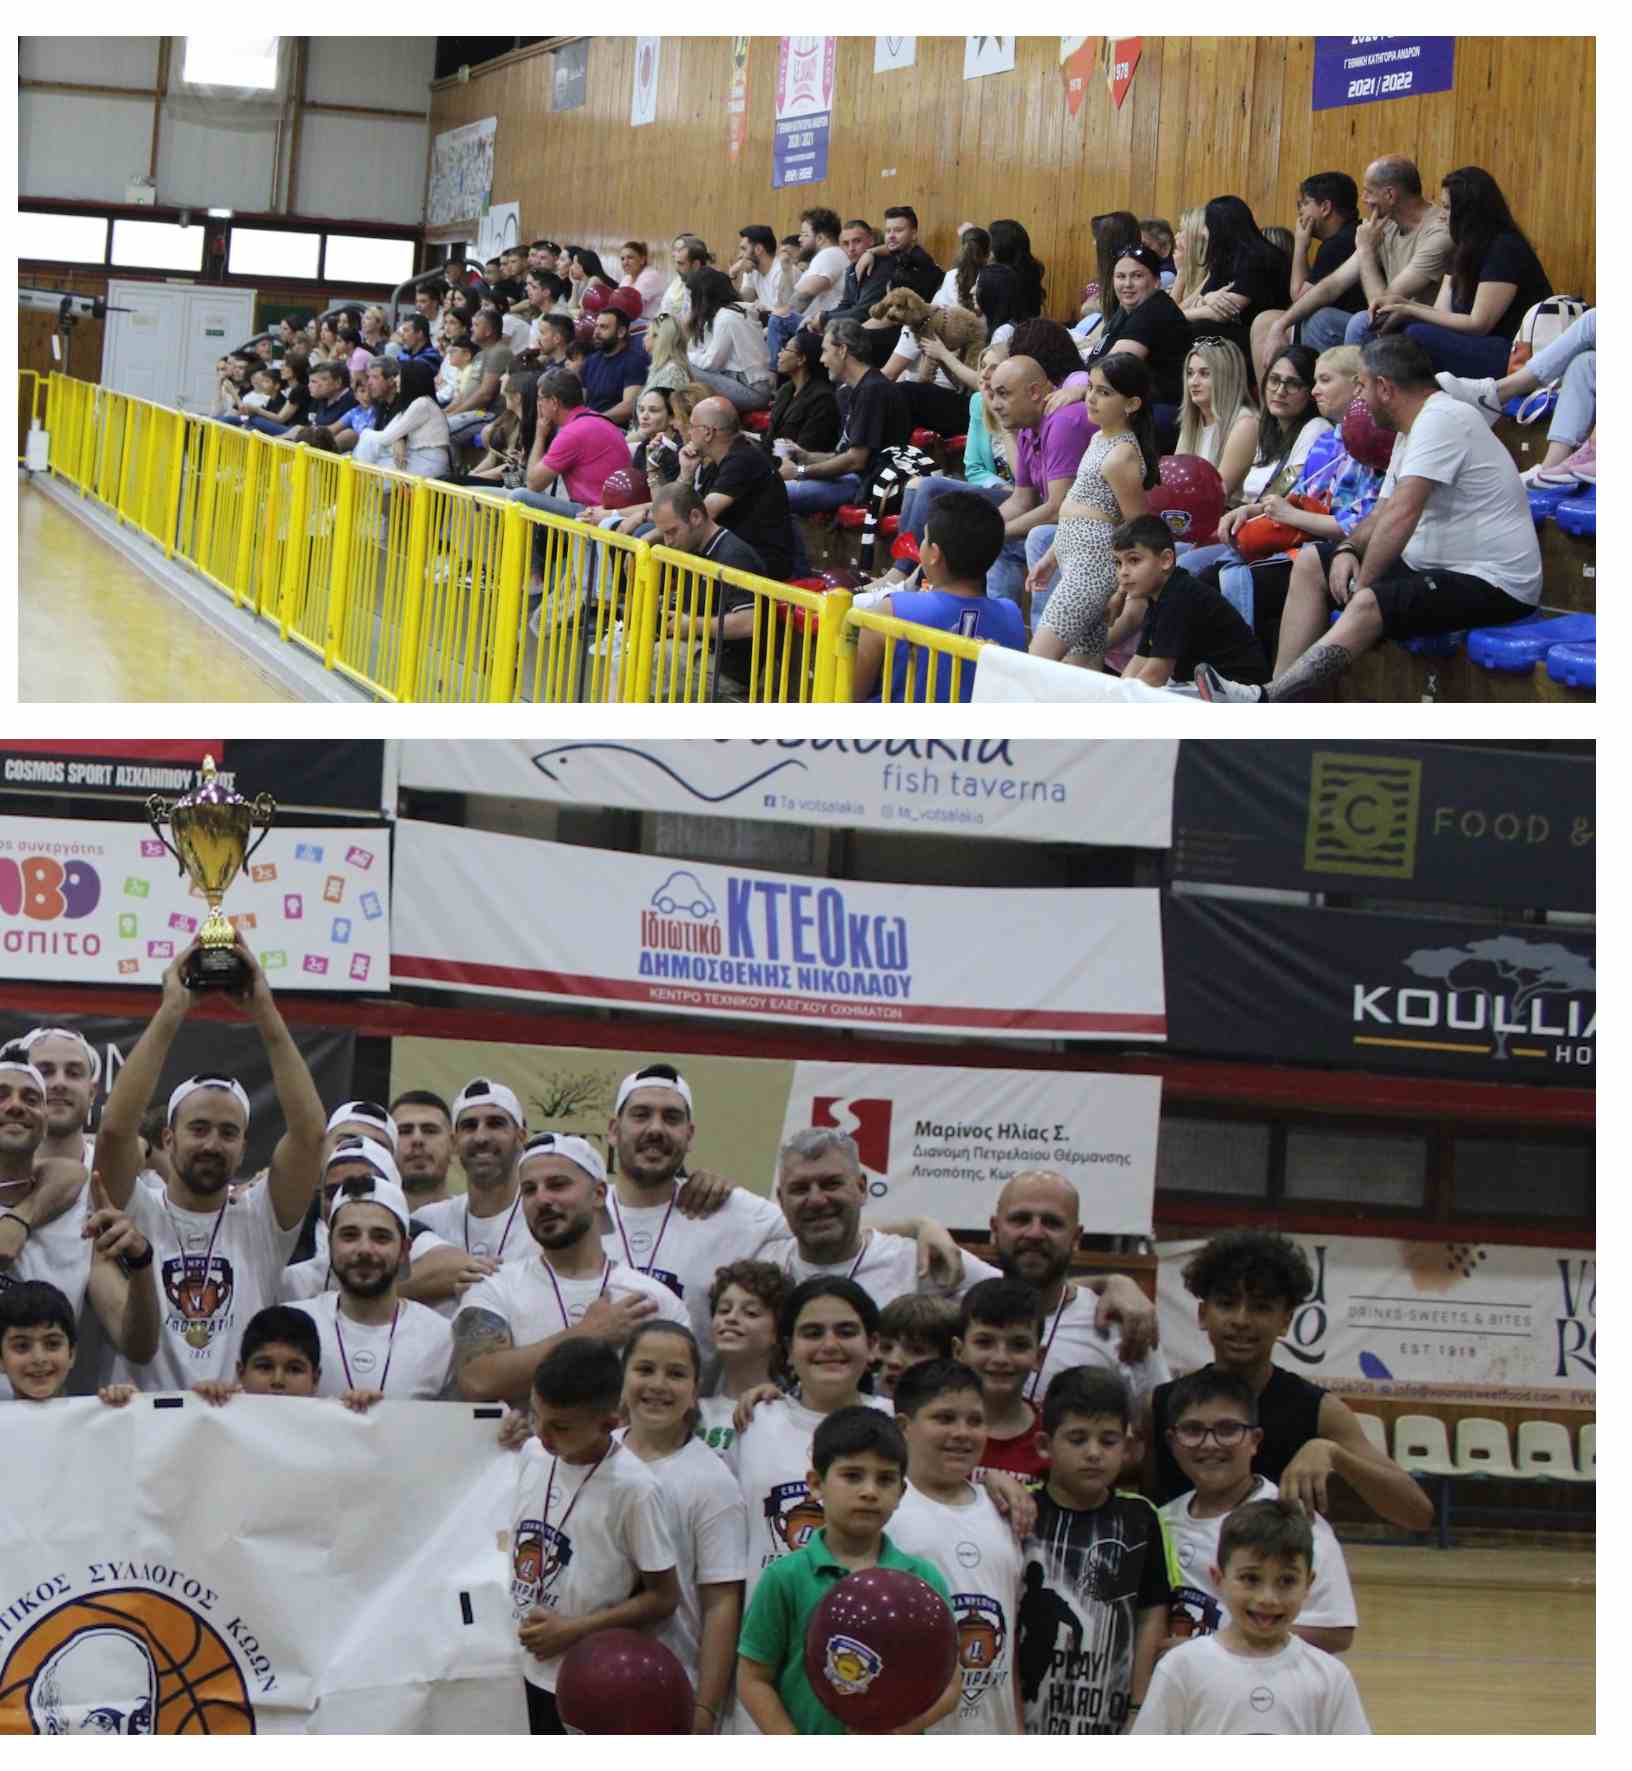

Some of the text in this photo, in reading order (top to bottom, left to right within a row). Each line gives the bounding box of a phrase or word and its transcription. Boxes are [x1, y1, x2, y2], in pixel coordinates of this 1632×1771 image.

[4, 758, 65, 783] COSMOS
[68, 762, 113, 786] SPORT
[883, 763, 1066, 803] fish taverna
[1432, 808, 1550, 843] FOOD
[640, 910, 721, 955] Ιδιωτικό
[639, 952, 912, 998] ΔΗΜΟΣΘΕΝΗΣ ΝΙΚΟΛΑΟΥ
[649, 987, 902, 1019] ΚΕΝΤΡΟ ΤΕΧΝΙΚΟΥ ΕΛΕΓΧΟΥ ΟΧΗΜΑΤΩΝ
[914, 1121, 1070, 1142] Μαρίνος Ηλίας Σ.
[912, 1144, 970, 1161] Διανομή
[1054, 1149, 1132, 1166] Θέρμανσης
[1487, 1313, 1532, 1328] BITES
[88, 1561, 219, 1611] ΣΥΛΛΟΓΟΣ
[225, 1616, 280, 1693] ΚΩΩΝ
[1049, 1651, 1103, 1681] PLAY
[1049, 1681, 1103, 1717] HARD
